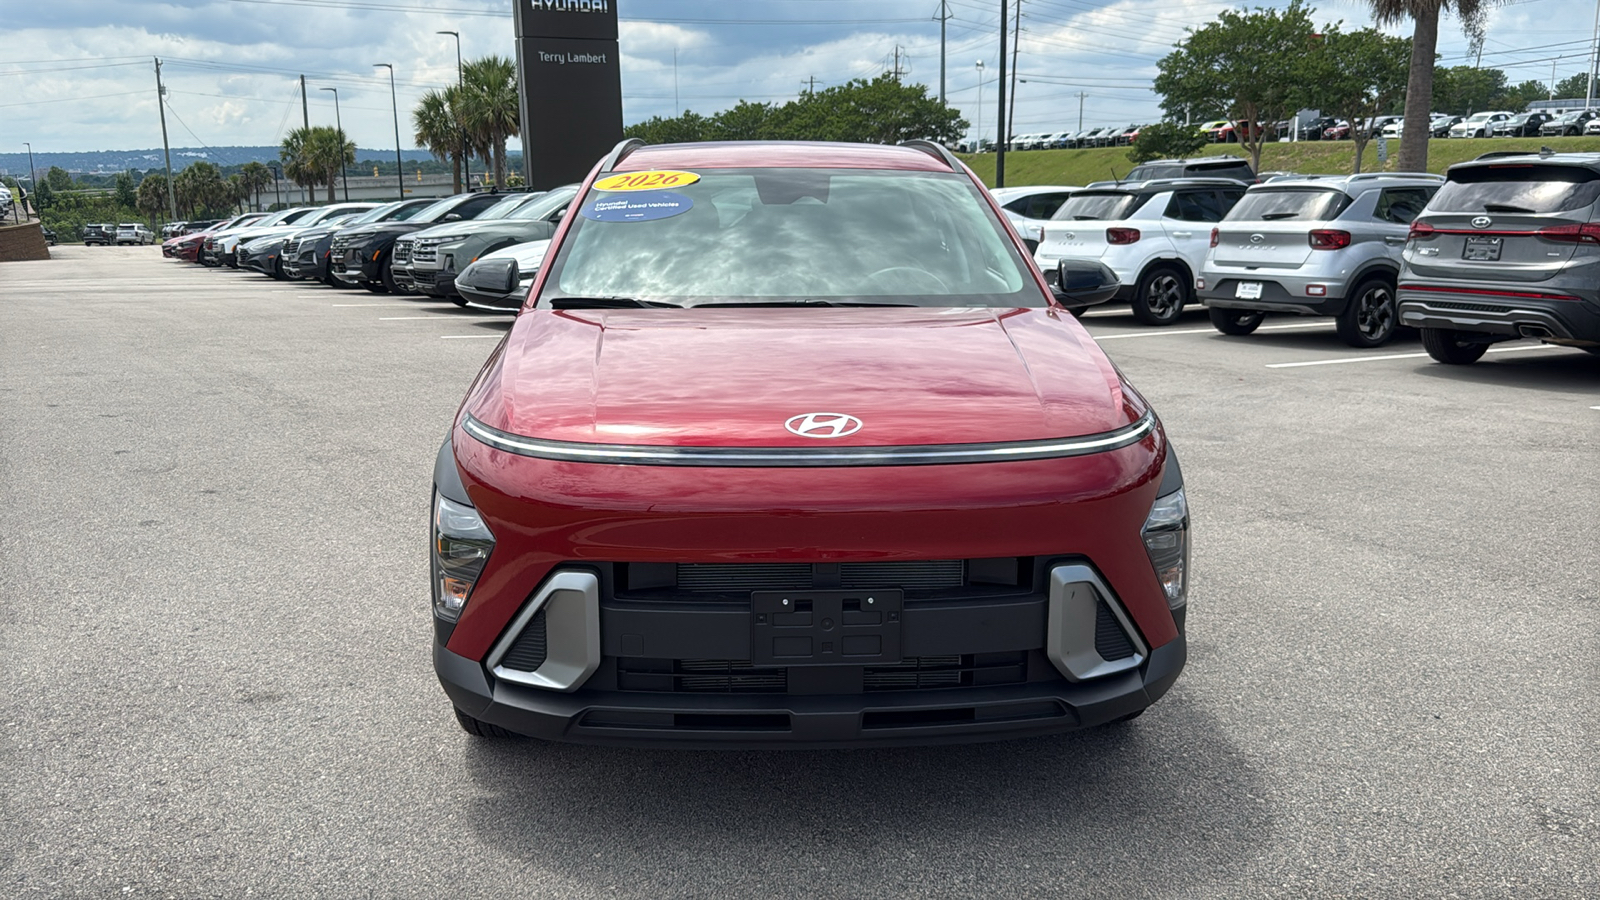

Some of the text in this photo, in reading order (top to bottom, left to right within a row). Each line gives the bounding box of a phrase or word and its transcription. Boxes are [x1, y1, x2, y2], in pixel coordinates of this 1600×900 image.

[531, 0, 608, 13] HYUNDAI
[538, 51, 607, 65] Terry Lambert
[609, 172, 685, 189] 2026
[596, 200, 628, 208] Hyundai
